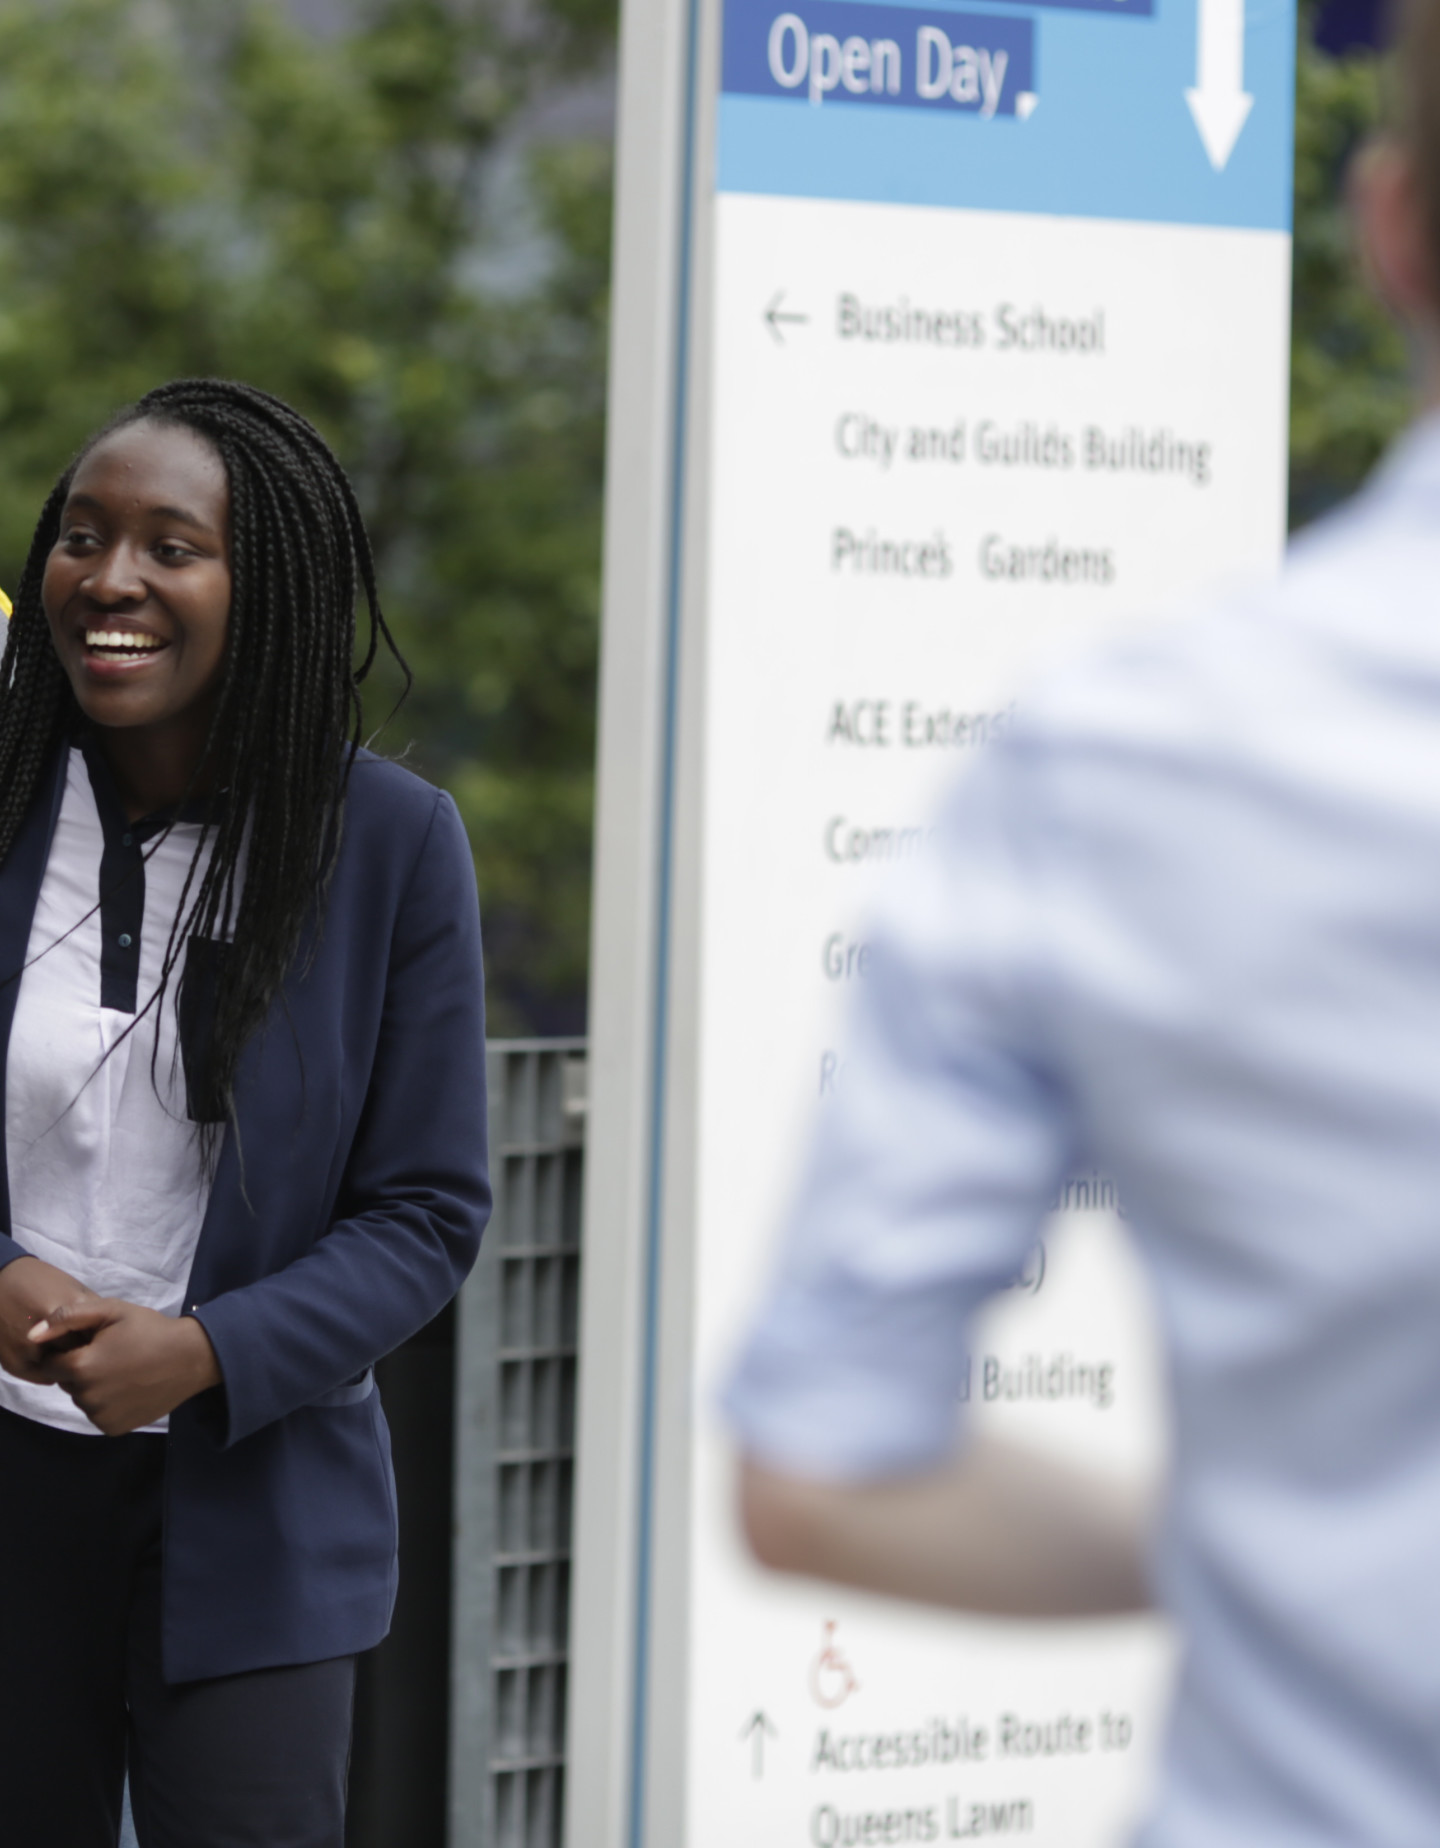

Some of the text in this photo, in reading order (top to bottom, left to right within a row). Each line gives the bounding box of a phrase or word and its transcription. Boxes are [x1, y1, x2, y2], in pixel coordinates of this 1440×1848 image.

[767, 12, 1009, 121] Open Day
[836, 291, 1106, 355] Business School
[835, 412, 1212, 488] City and Guilds Building
[978, 532, 1114, 585] Gardens
[826, 700, 891, 748] ACE
[983, 1354, 1115, 1410] Building
[810, 1708, 1133, 1775] Accessible Route to
[810, 1793, 1034, 1848] Queens Lawn
